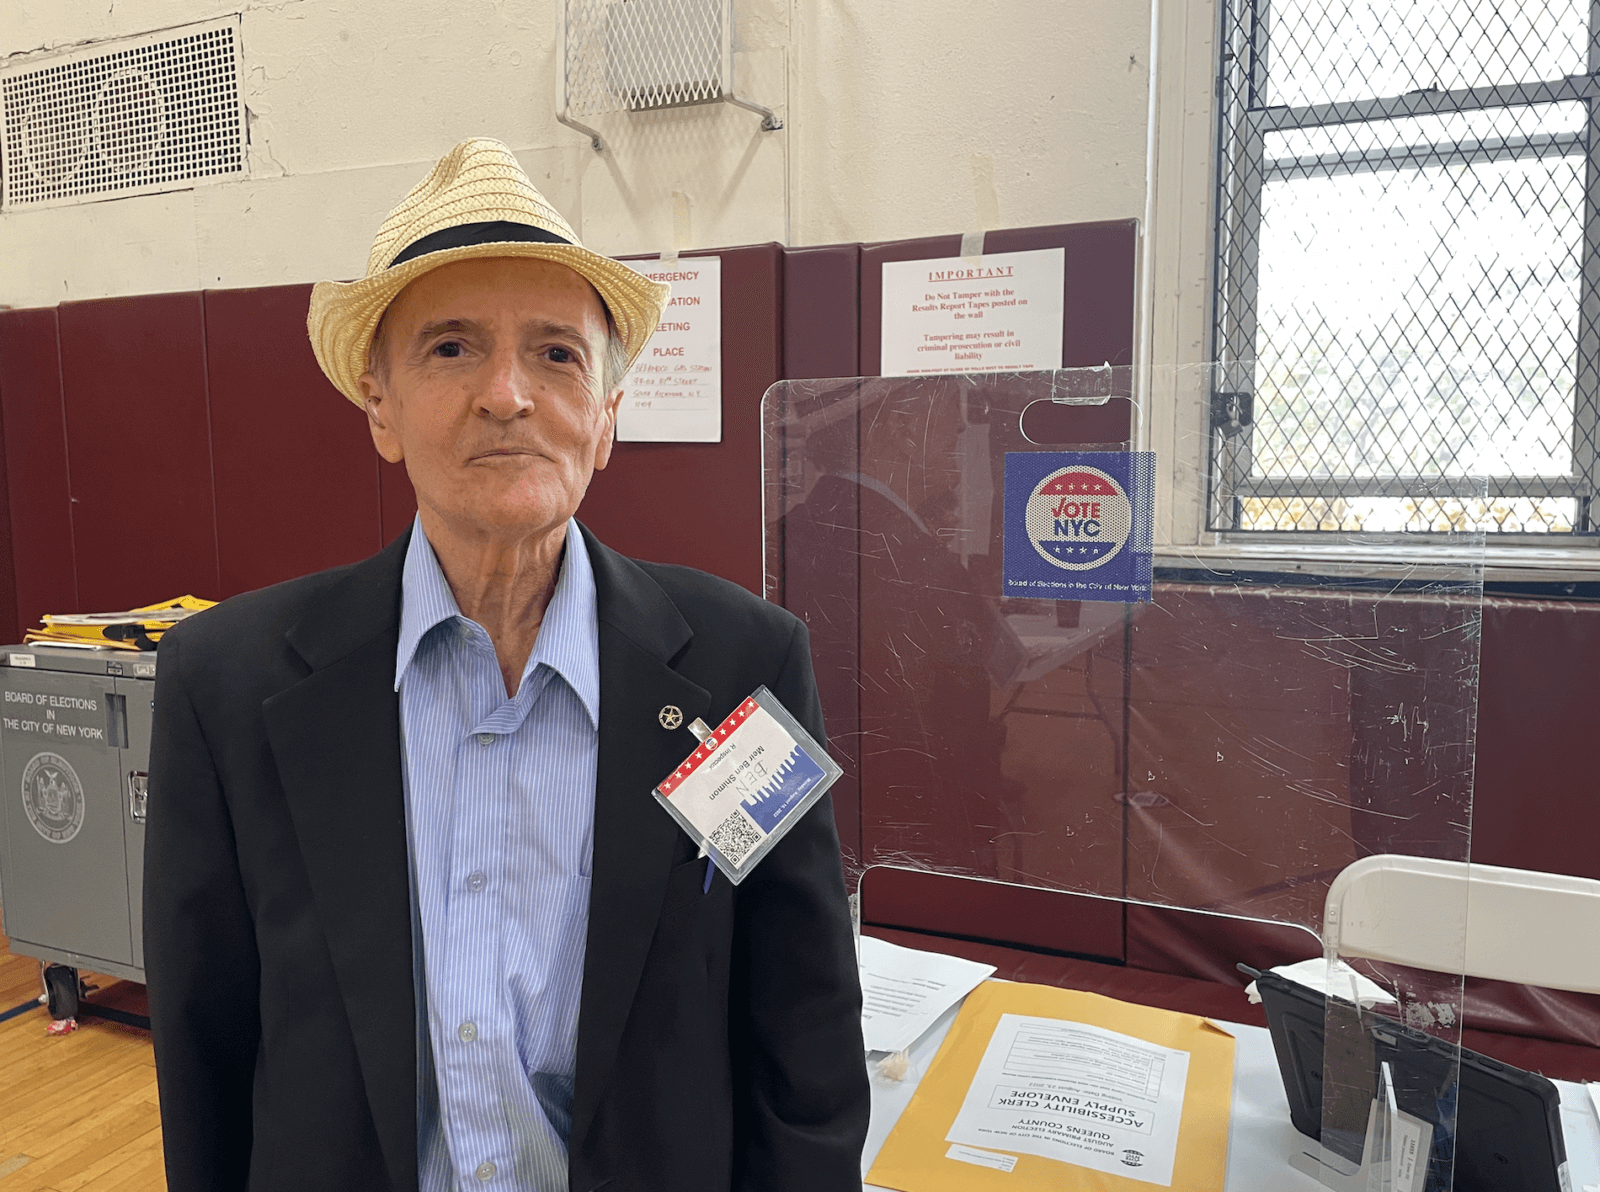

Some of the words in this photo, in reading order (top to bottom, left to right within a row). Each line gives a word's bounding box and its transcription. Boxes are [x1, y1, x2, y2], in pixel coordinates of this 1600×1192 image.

[644, 271, 699, 281] MERGENCY
[929, 266, 1013, 282] IMPORTANT
[952, 292, 981, 300] Tamper
[984, 289, 1000, 297] with
[1003, 288, 1014, 296] the
[669, 297, 700, 306] ATION
[912, 304, 938, 312] Results
[940, 302, 965, 311] Report
[968, 301, 990, 310] Tapes
[992, 299, 1016, 308] posted
[656, 322, 690, 332] EETING
[923, 333, 964, 342] Tampering
[983, 330, 1005, 338] result
[653, 347, 684, 357] PLACE
[917, 343, 947, 352] criminal
[950, 341, 992, 352] prosecution
[955, 352, 982, 361] liability
[1052, 497, 1100, 519] VOTE
[1054, 519, 1100, 537] NYC
[1008, 579, 1027, 587] Board
[1037, 580, 1067, 588] Elections
[5, 691, 34, 704] BOARD
[36, 694, 48, 705] OF
[50, 695, 98, 711] ELECTIONS
[46, 709, 56, 720] IN
[3, 717, 20, 730] THE
[21, 720, 40, 732] CITY
[42, 722, 55, 734] OF
[56, 724, 77, 737] NEW
[78, 726, 103, 740] YORK
[729, 742, 737, 750] R
[709, 748, 732, 770] Inspector
[748, 745, 765, 761] Meir
[734, 760, 751, 775] Ben
[735, 759, 768, 798] BEN
[709, 774, 737, 801] Shimon
[1058, 1085, 1080, 1093] August
[998, 1098, 1039, 1108] CLERK
[1010, 1090, 1079, 1105] ENVELOPE
[1101, 1093, 1123, 1102] Voting
[1044, 1102, 1144, 1128] ACCESSIBILITY
[1085, 1101, 1136, 1117] SUPPLY
[1012, 1124, 1046, 1132] ELECTION
[1018, 1118, 1063, 1129] COUNTY
[1047, 1129, 1081, 1141] PRIMARY
[1066, 1125, 1111, 1140] QUEENS
[1052, 1137, 1083, 1149] ELECTIONS
[1083, 1137, 1115, 1148] AUGUST
[1093, 1148, 1115, 1156] BOARD
